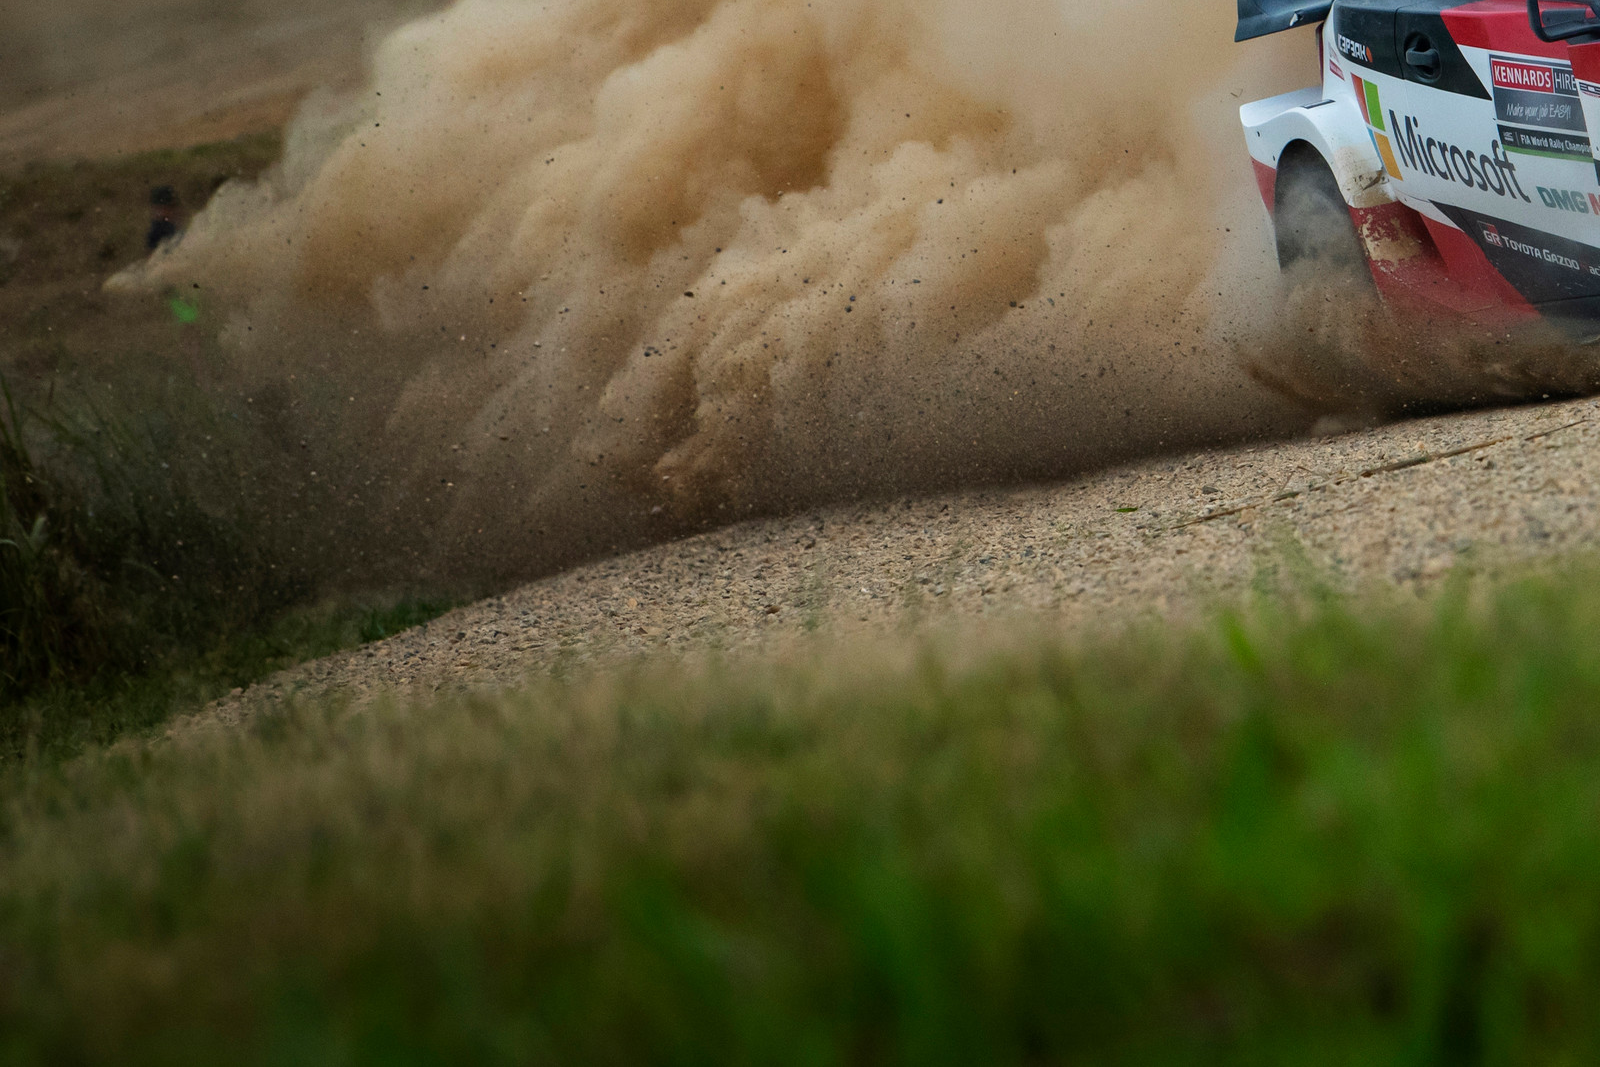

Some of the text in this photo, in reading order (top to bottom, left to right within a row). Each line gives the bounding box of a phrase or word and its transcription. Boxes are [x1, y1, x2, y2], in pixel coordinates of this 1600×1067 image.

[1494, 65, 1577, 91] KENNARDS HIRE
[1506, 102, 1524, 116] Make
[1389, 109, 1532, 203] Microsoft
[1520, 134, 1531, 145] FIA
[1531, 136, 1548, 148] World
[1549, 138, 1564, 152] Rally
[1536, 186, 1589, 214] DMG
[1483, 229, 1502, 247] GR
[1501, 235, 1542, 260] TOYOTA
[1543, 249, 1580, 271] GAZOO
